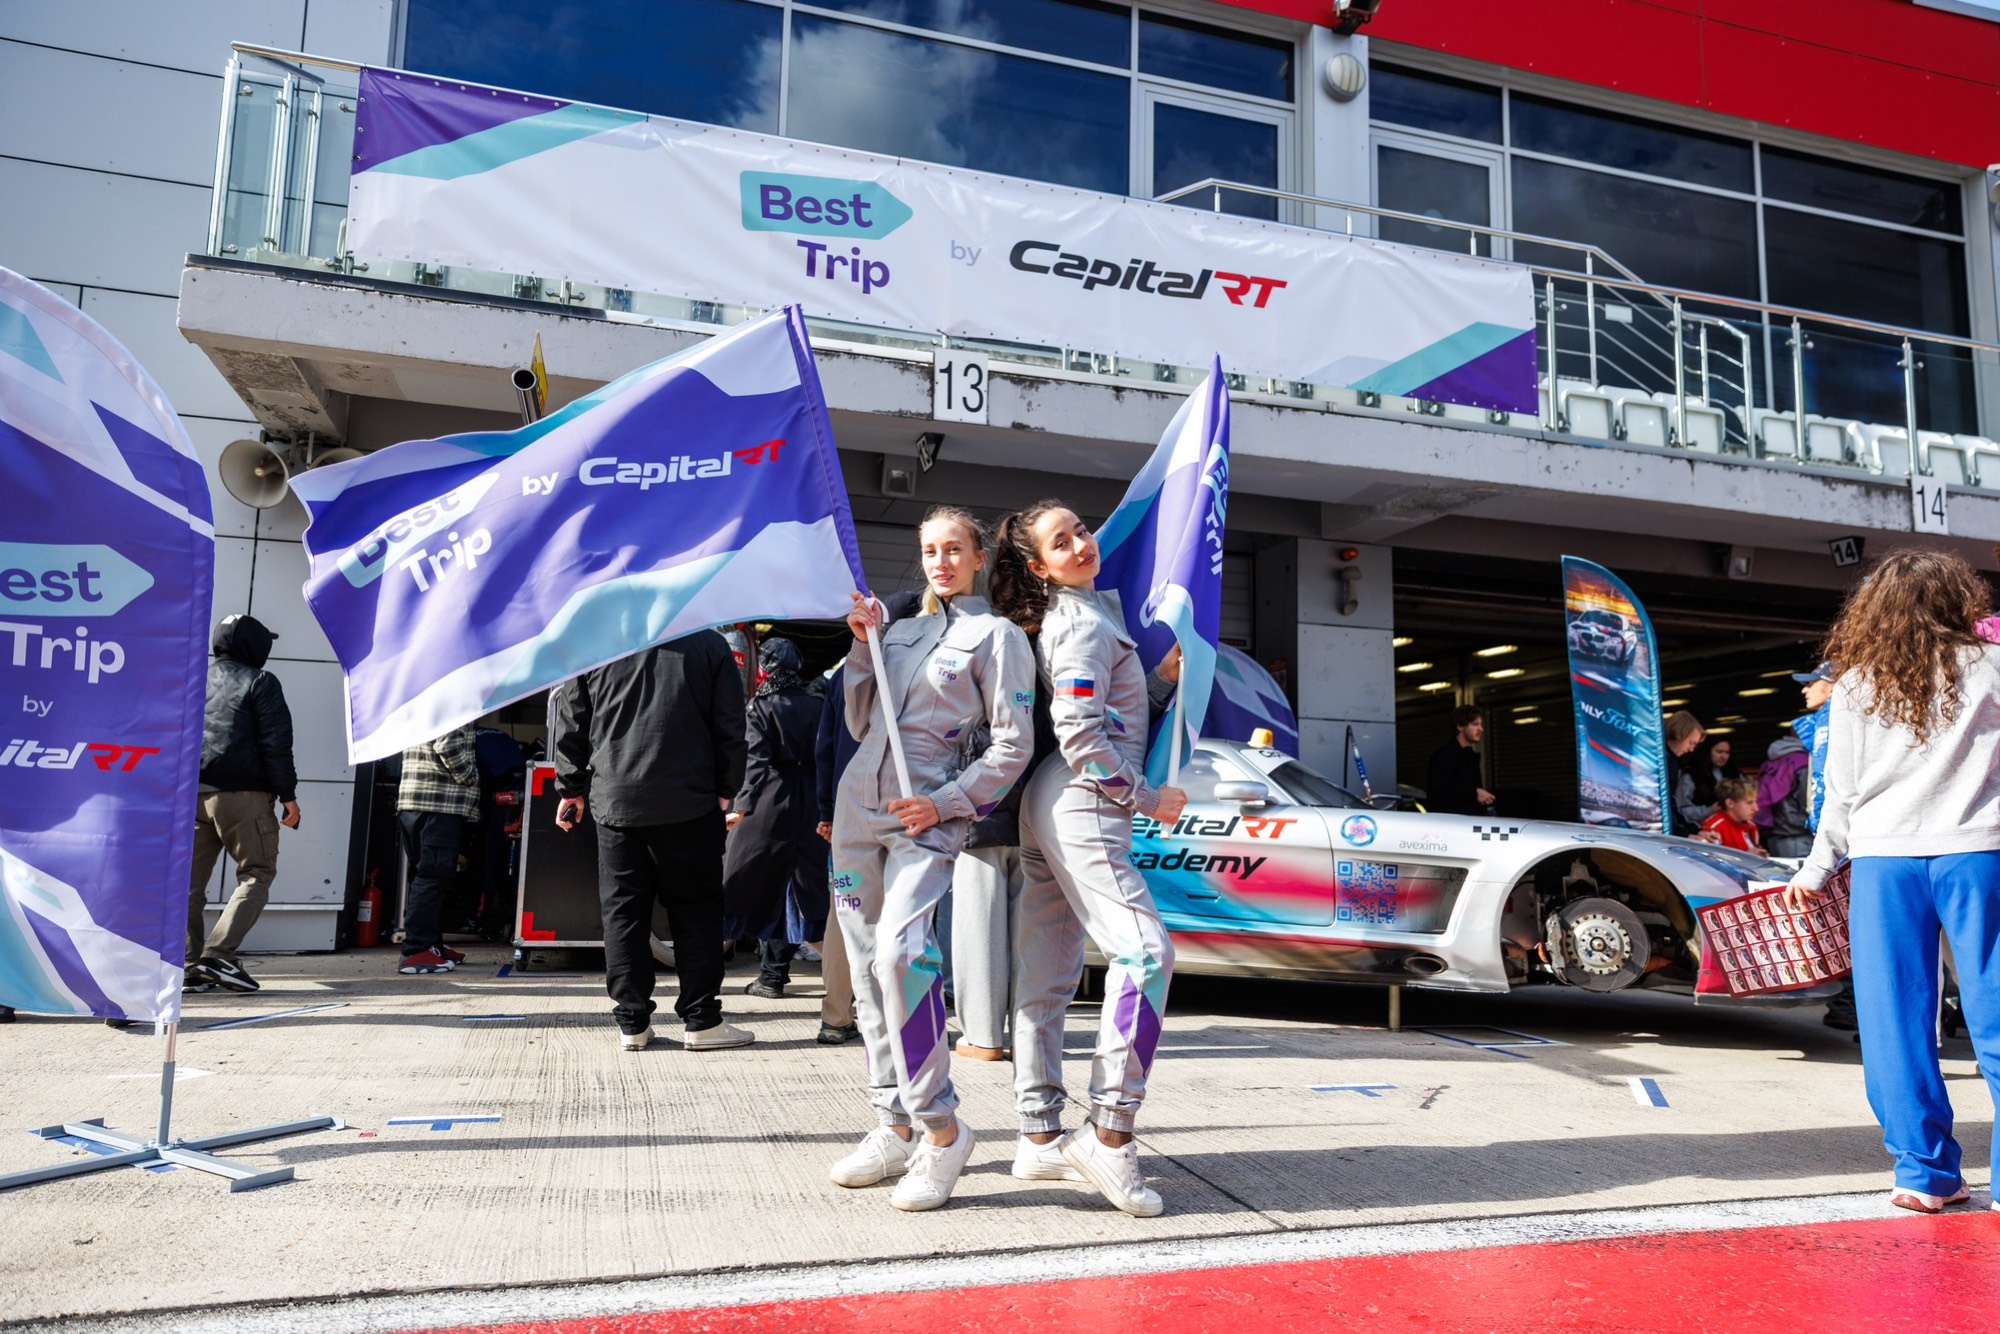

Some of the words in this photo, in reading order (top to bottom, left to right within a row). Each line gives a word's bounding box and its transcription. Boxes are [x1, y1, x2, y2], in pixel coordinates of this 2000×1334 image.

[760, 184, 873, 228] Best
[797, 239, 890, 294] Trip
[951, 240, 982, 266] by
[939, 361, 984, 413] 13
[1916, 485, 1945, 525] 14
[354, 491, 461, 568] Best
[399, 528, 492, 593] Trip
[522, 472, 559, 496] by
[1834, 541, 1856, 562] 14
[0, 561, 103, 602] est
[0, 621, 125, 684] Trip
[934, 657, 957, 668] Best
[938, 667, 957, 681] Trip
[22, 694, 54, 717] by
[1399, 840, 1448, 852] avexima
[835, 894, 861, 911] Trip
